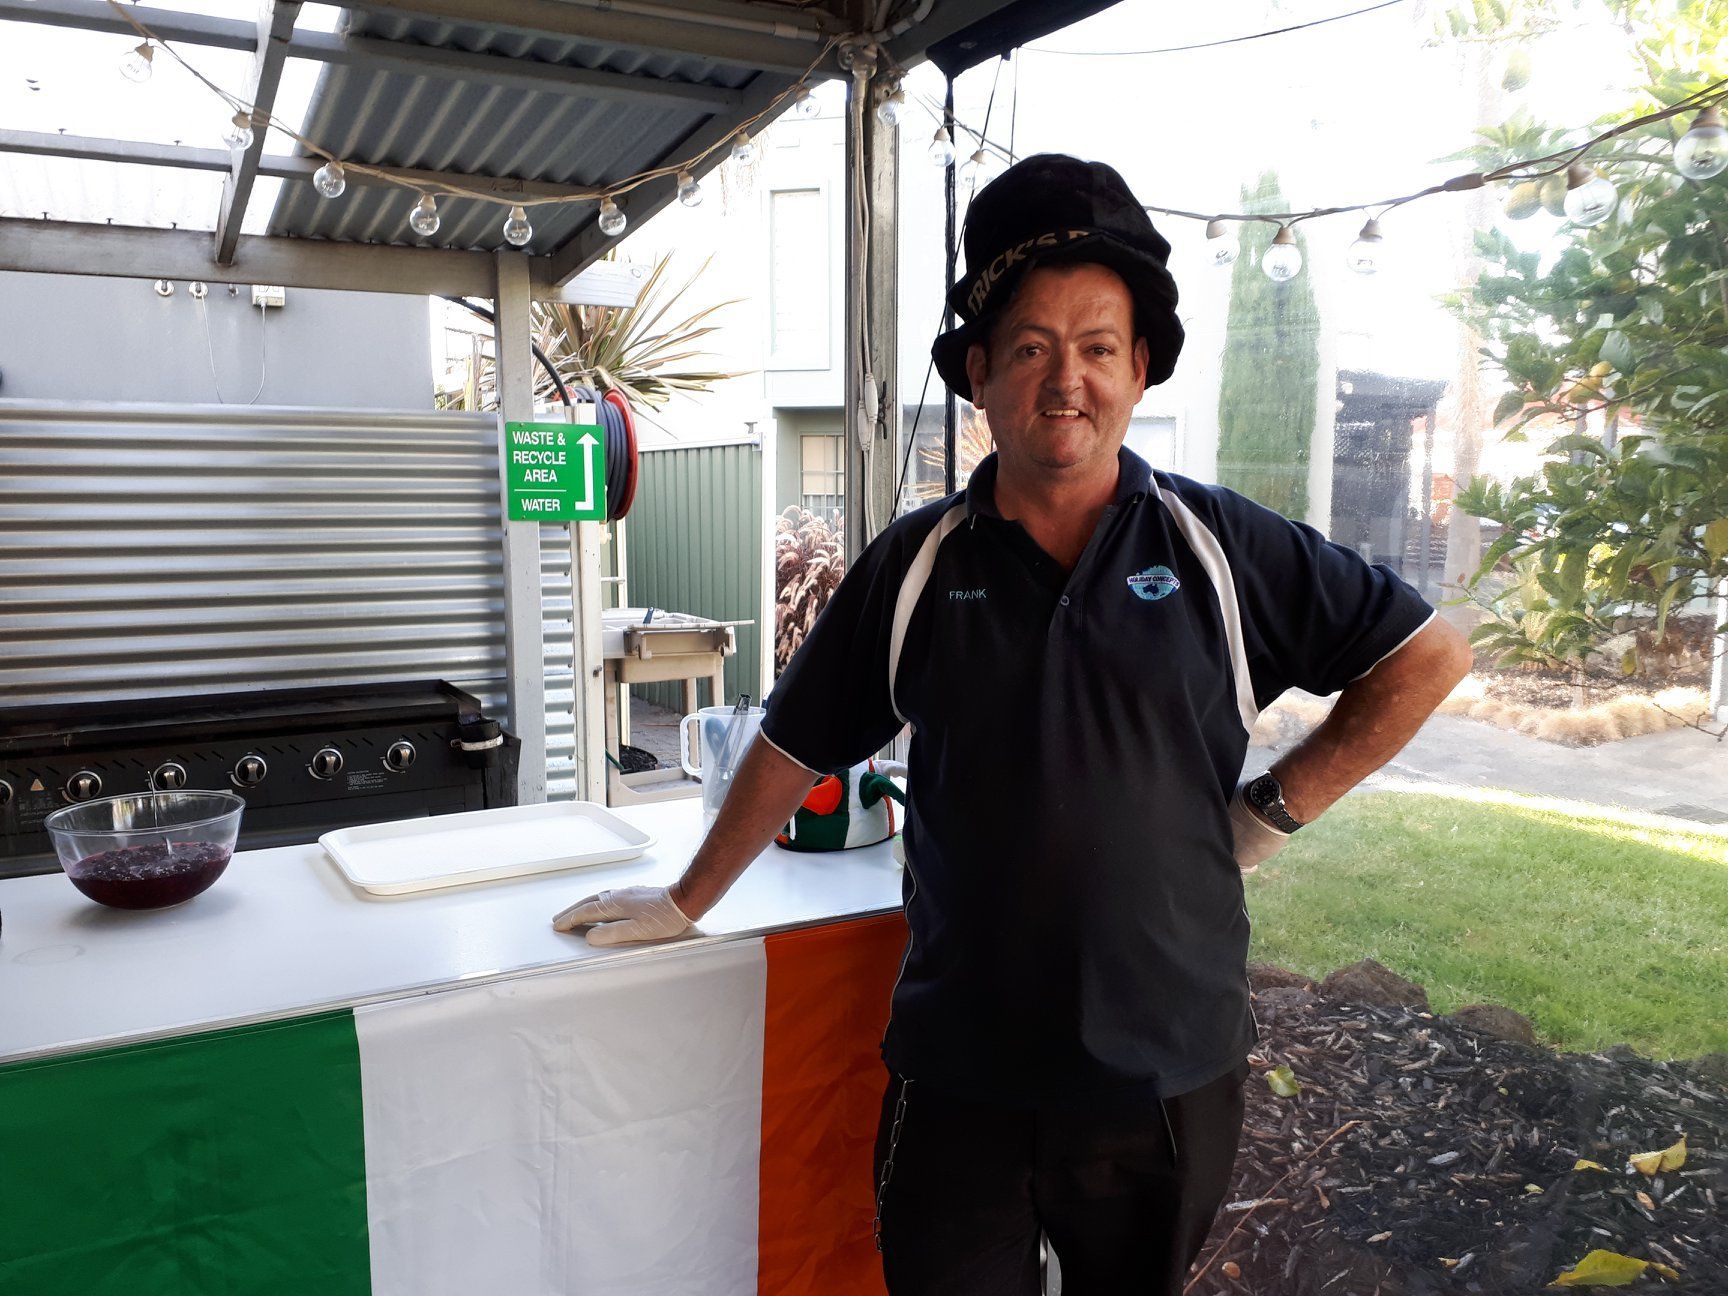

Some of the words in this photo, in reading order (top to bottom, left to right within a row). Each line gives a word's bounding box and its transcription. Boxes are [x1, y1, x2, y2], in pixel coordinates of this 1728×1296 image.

[512, 431, 554, 445] WASTE
[557, 432, 566, 446] &
[513, 451, 567, 465] RECYCLE
[524, 469, 558, 482] AREA
[521, 498, 561, 511] WATER
[1129, 575, 1152, 583] HOLIDAY
[1152, 575, 1180, 587] CONCEPTS
[949, 588, 987, 600] FRANK
